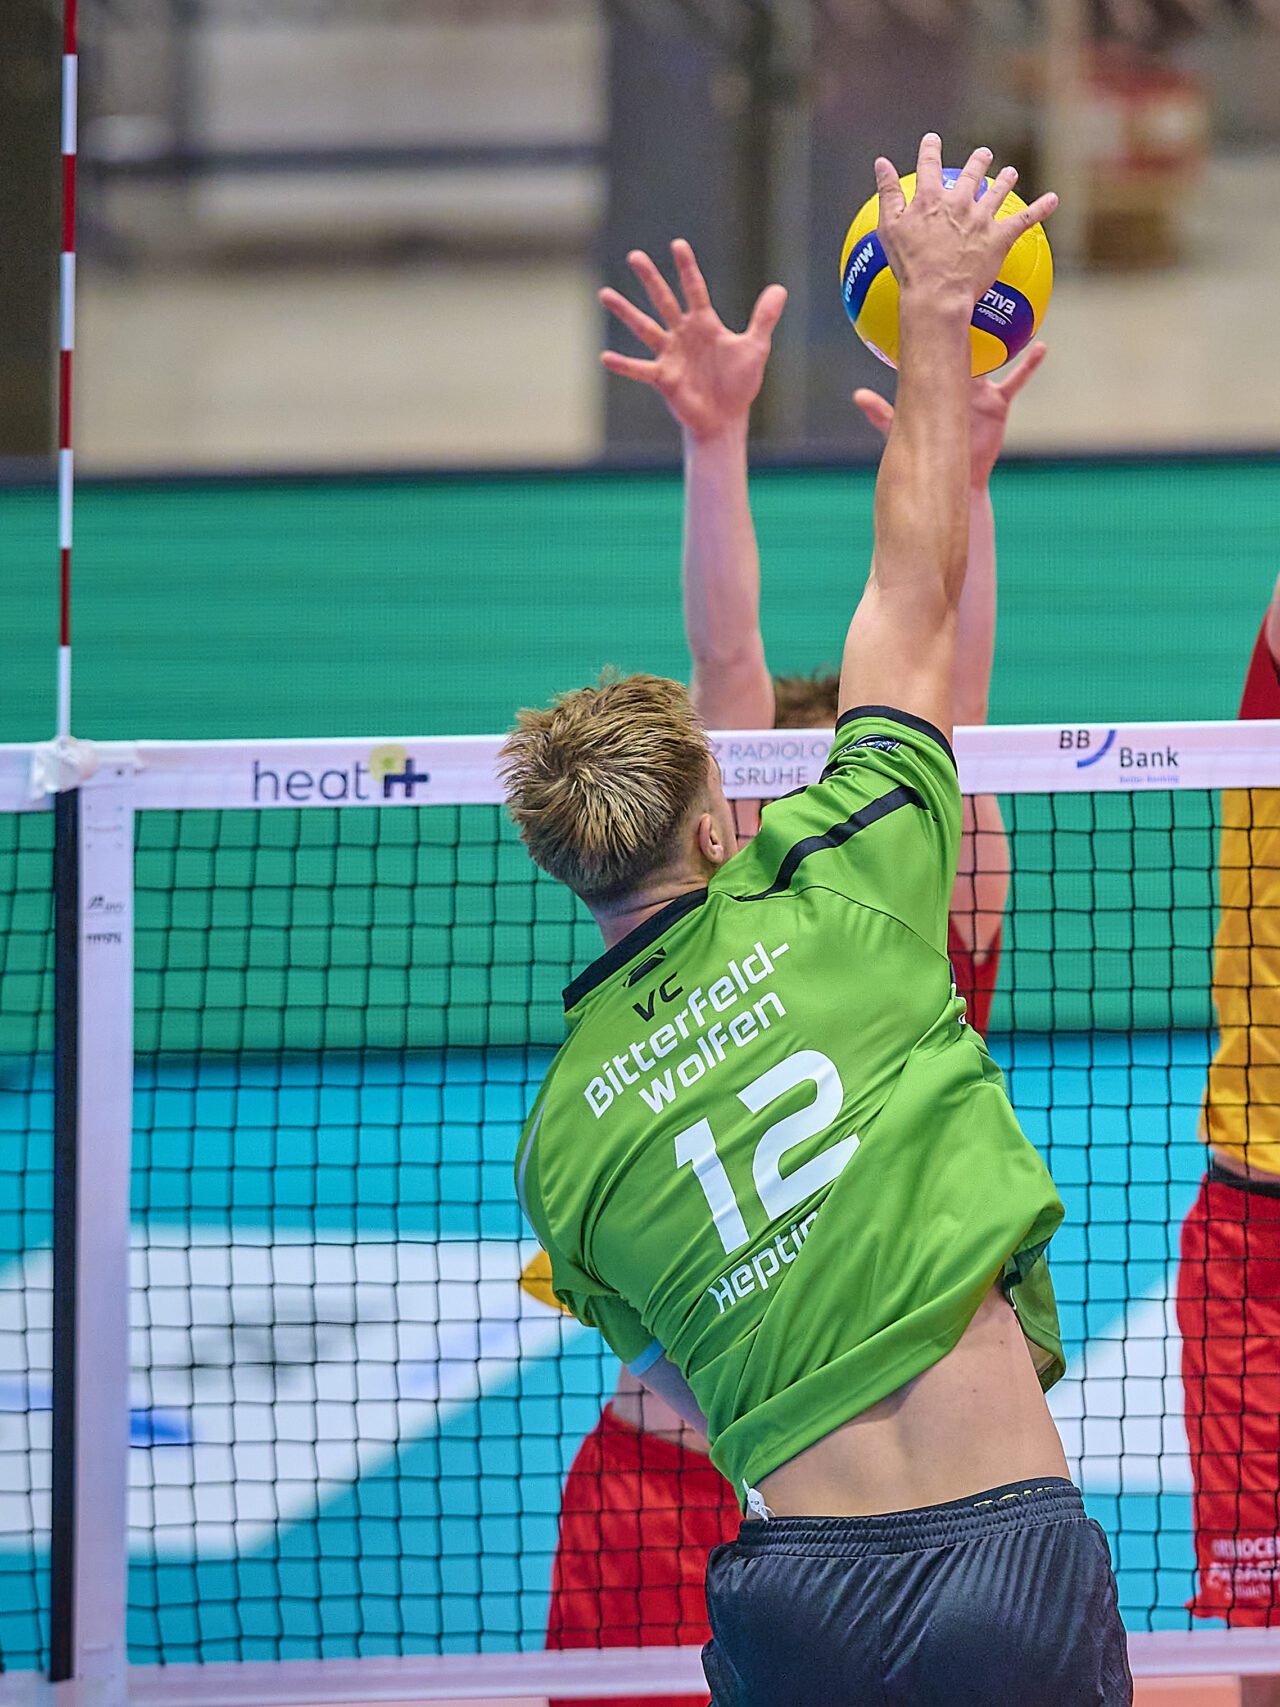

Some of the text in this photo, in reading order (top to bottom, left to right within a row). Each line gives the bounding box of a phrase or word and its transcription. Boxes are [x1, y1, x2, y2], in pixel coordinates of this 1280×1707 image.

[983, 288, 1017, 316] FIVB
[729, 742, 831, 760] RADIOLO
[1059, 729, 1091, 750] BB
[1119, 746, 1180, 768] Bank
[252, 759, 370, 802] heat
[720, 766, 810, 786] LSRUHE
[632, 971, 684, 1023] VC
[583, 941, 790, 1120] Bitterfeld-
[673, 1050, 861, 1256] 12
